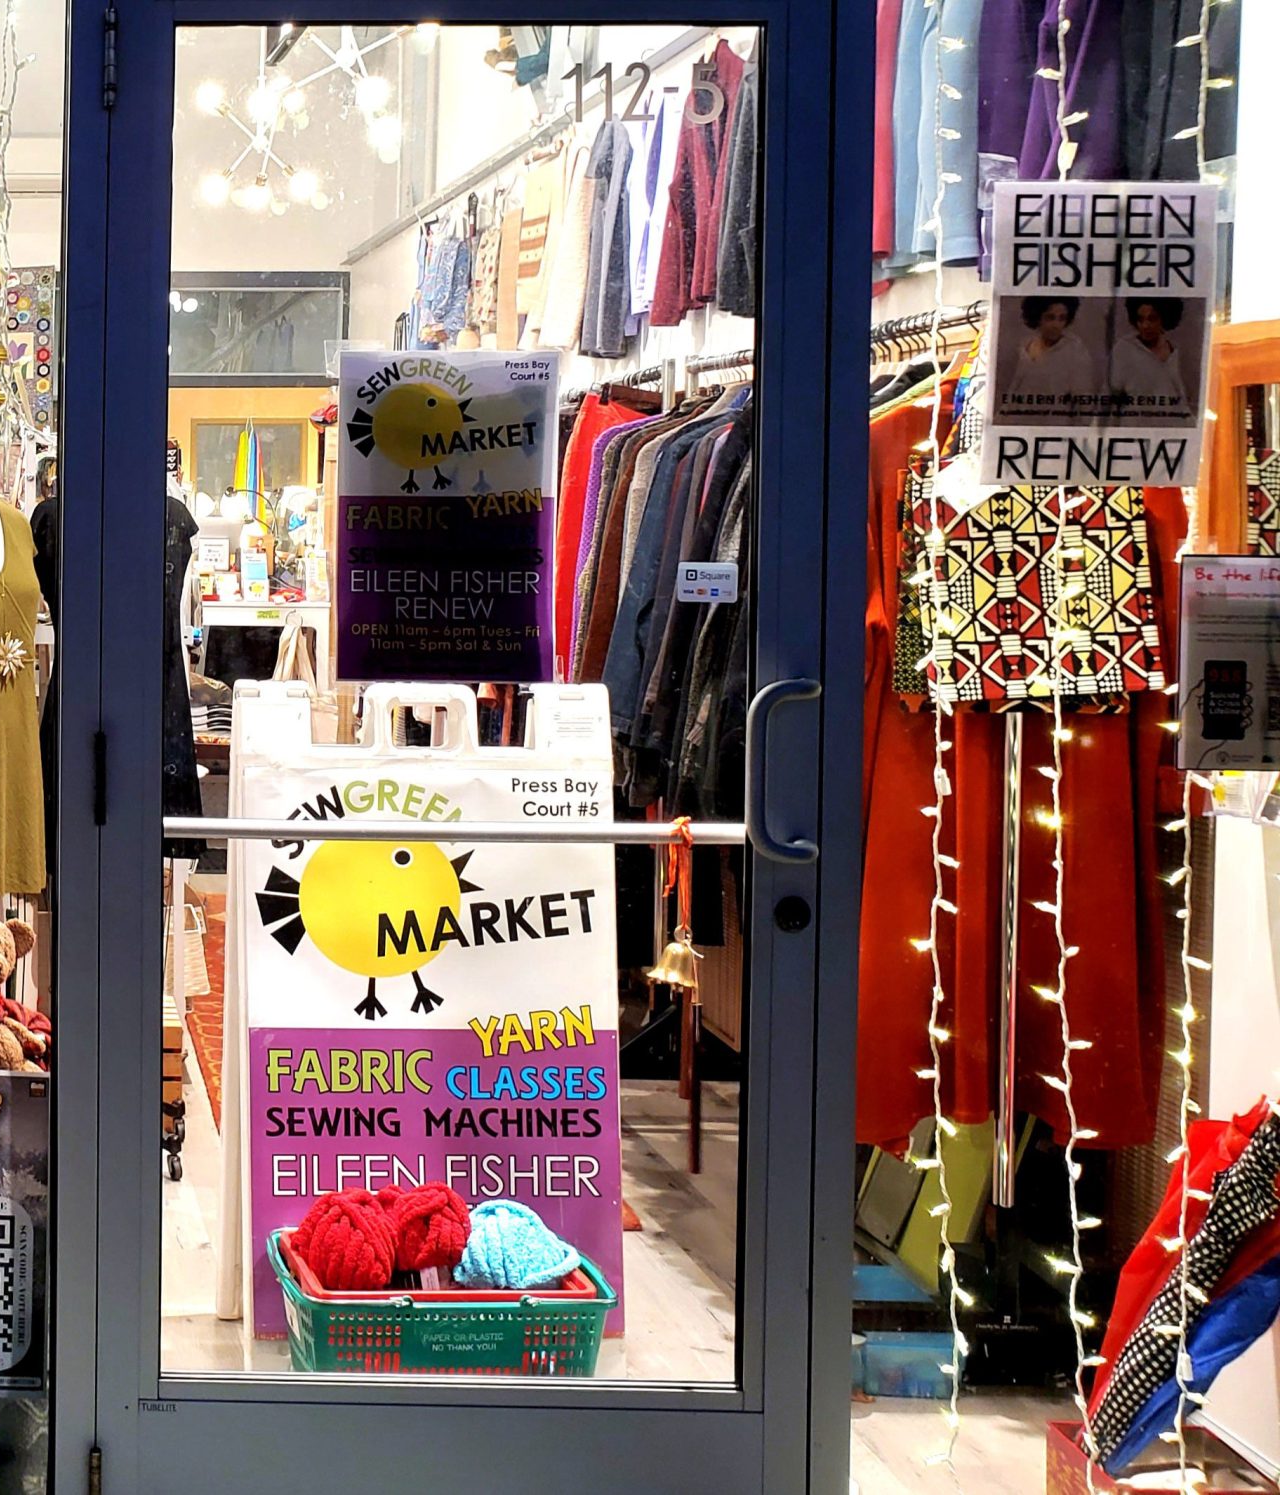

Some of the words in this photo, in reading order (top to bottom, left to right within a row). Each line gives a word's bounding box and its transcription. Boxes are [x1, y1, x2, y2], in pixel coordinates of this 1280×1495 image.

[1013, 193, 1196, 239] EILEEN
[1013, 242, 1196, 288] FISHER
[504, 360, 529, 370] Press
[532, 360, 550, 371] Bay
[509, 371, 537, 381] Court
[538, 372, 550, 381] #5
[420, 421, 537, 458] MARKET
[996, 435, 1188, 482] RENEW
[465, 487, 545, 519] YARN
[346, 504, 451, 531] FABRIC
[350, 569, 439, 593] EILEEN
[450, 570, 540, 595] FISHER
[698, 570, 731, 582] Square
[1194, 566, 1214, 580] Be
[1222, 568, 1252, 581] the
[395, 596, 495, 620] RENEW
[351, 623, 389, 636] OPEN
[394, 623, 428, 636] 11am
[443, 624, 476, 640] 6pm
[480, 625, 512, 638] Tues
[524, 625, 540, 638] Fri
[370, 638, 405, 650] 11am
[420, 638, 451, 653] 5pm
[482, 639, 491, 651] &
[496, 639, 522, 652] Sun
[511, 777, 558, 794] Press
[564, 777, 599, 797] Bay
[522, 801, 573, 818] Court
[577, 801, 600, 817] #5
[376, 888, 596, 958] MARKET
[467, 1004, 597, 1058] YARN
[266, 1048, 433, 1094] FABRIC
[445, 1065, 607, 1101] CLASSES
[265, 1106, 402, 1137] SEWING
[423, 1106, 603, 1138] MACHINES
[271, 1153, 426, 1197] EILEEN
[444, 1154, 602, 1198] FISHER
[423, 1333, 451, 1342] PAPER
[453, 1333, 466, 1341] OR
[468, 1332, 504, 1342] PLASTIC
[432, 1344, 443, 1352] NO
[447, 1343, 474, 1352] THANK
